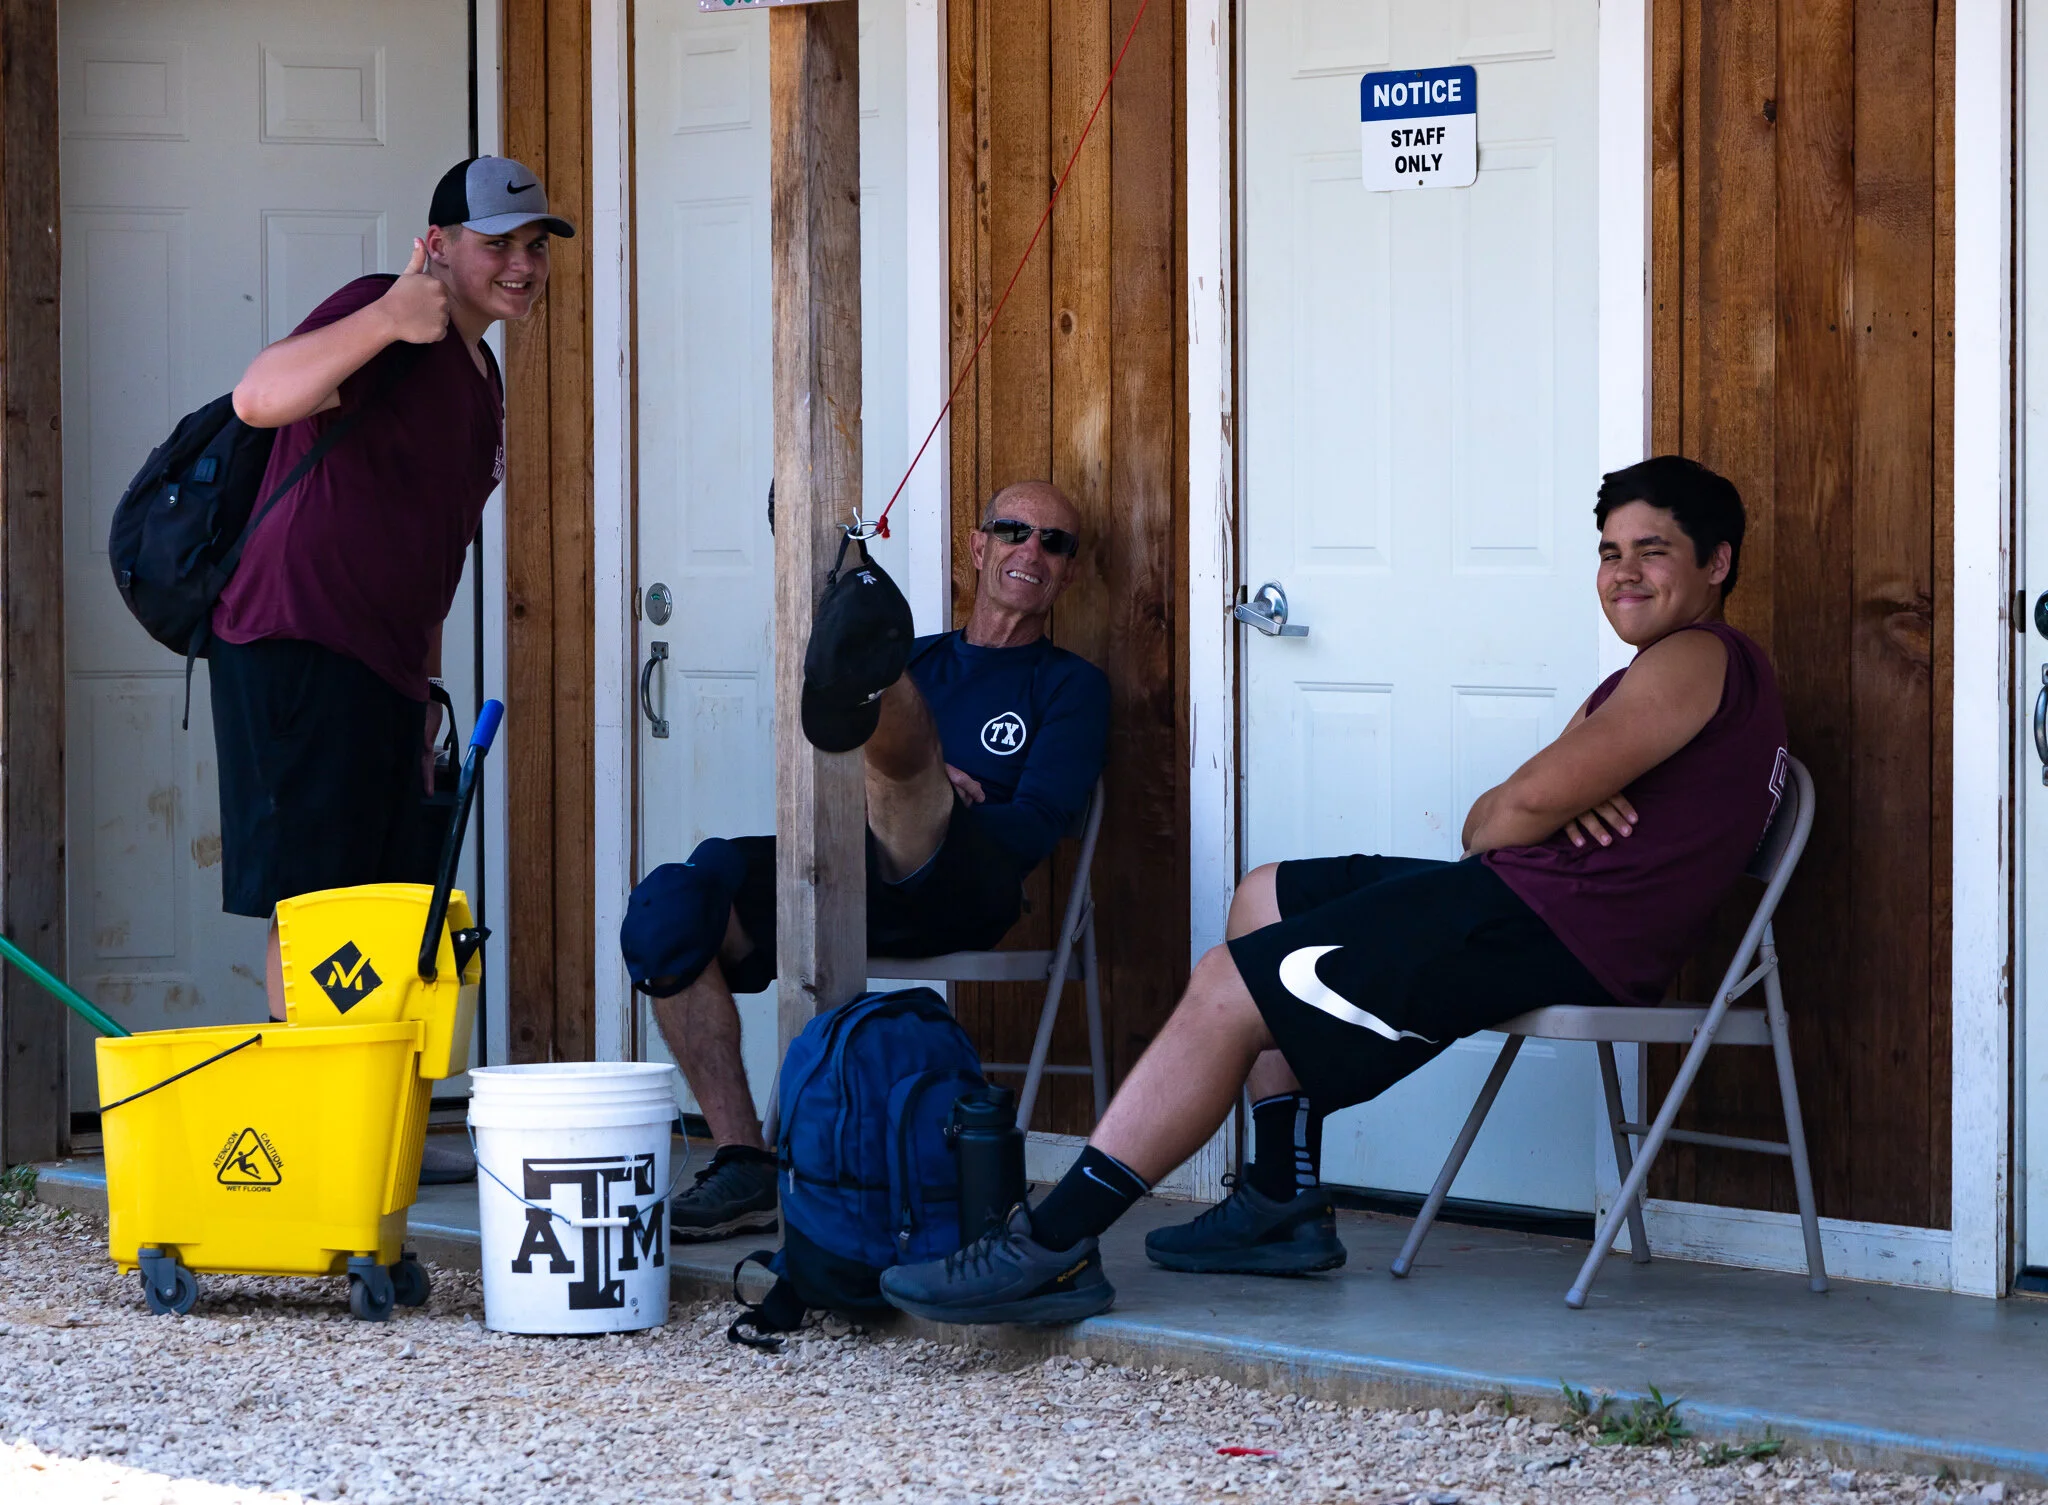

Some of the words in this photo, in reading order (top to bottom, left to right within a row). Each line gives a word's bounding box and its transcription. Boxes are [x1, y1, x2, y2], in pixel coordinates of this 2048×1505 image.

[1373, 79, 1462, 108] NOTICE
[1390, 126, 1446, 148] STAFF
[1394, 153, 1443, 174] ONLY
[989, 721, 1020, 747] TX
[213, 1131, 239, 1169] ATENCION
[260, 1132, 285, 1169] CAUTION
[243, 1185, 272, 1193] FLOORS
